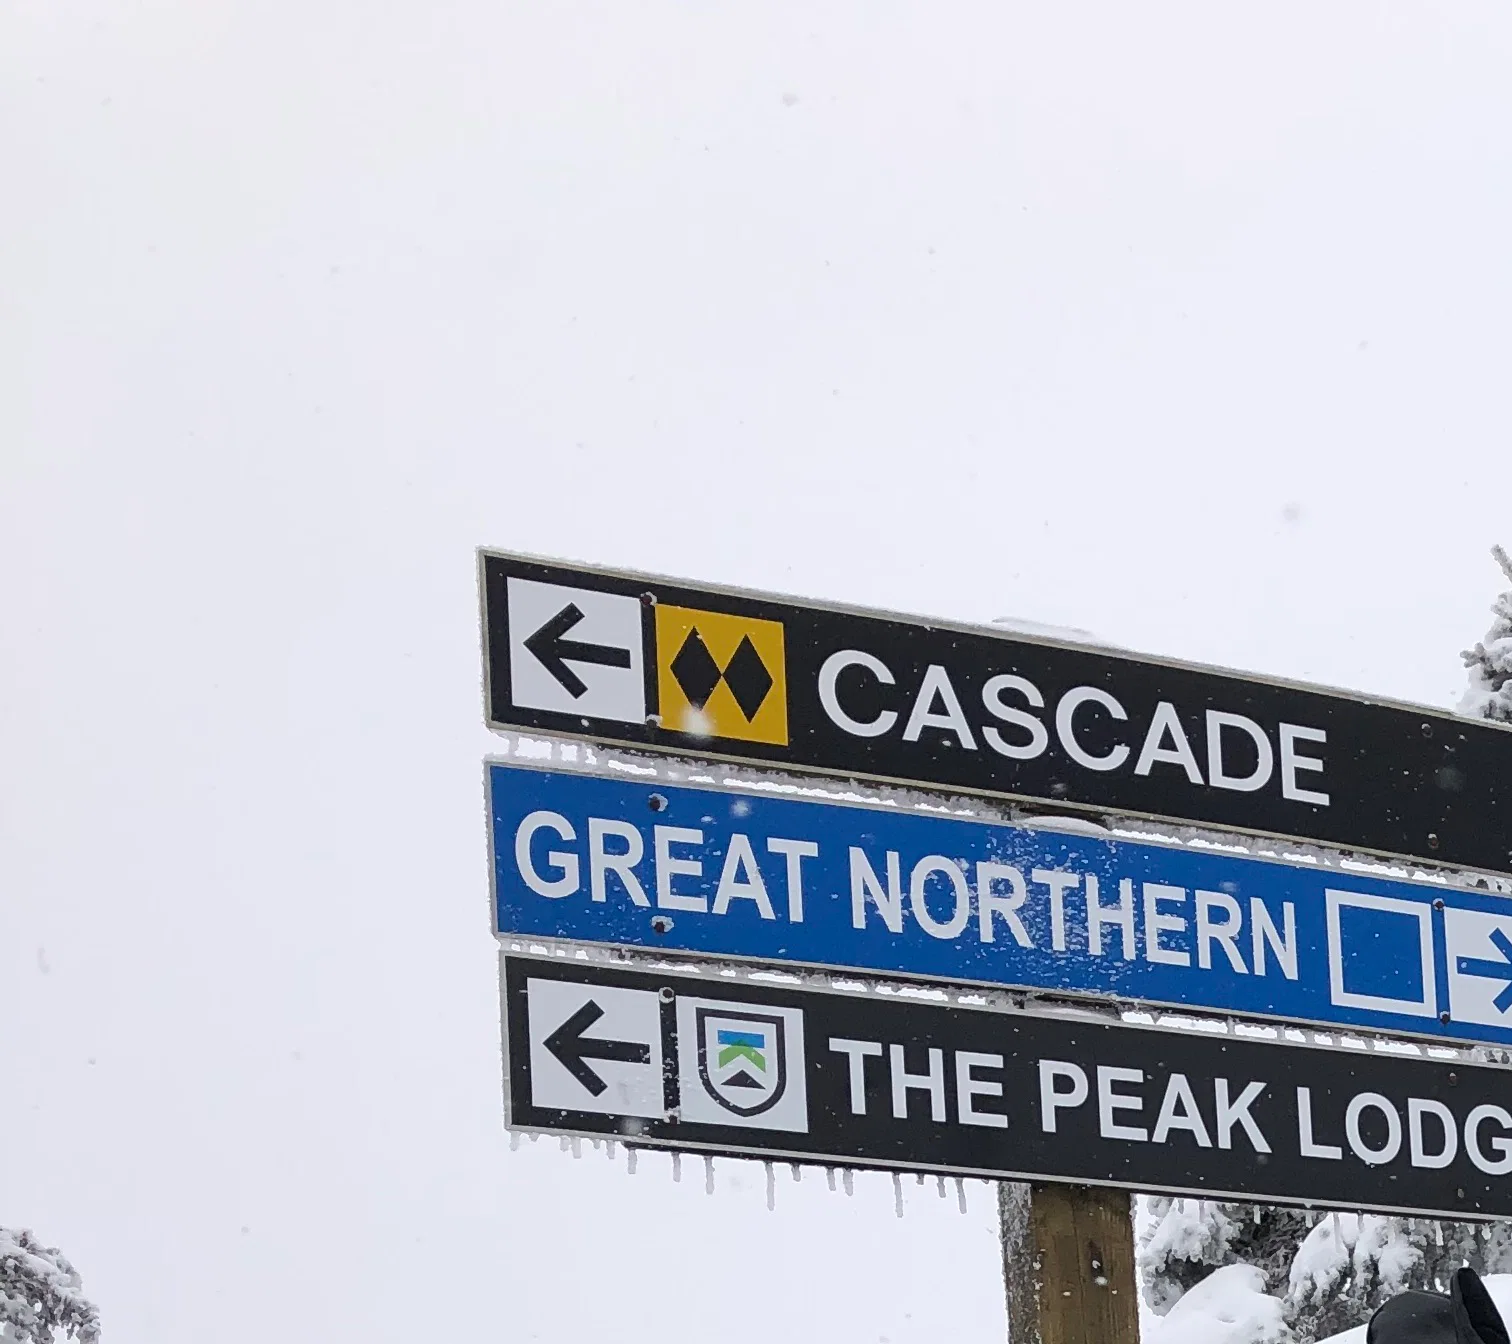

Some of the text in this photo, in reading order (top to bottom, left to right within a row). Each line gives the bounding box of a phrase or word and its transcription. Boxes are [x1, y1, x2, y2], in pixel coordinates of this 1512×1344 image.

[818, 648, 1330, 807] CASCADE
[514, 809, 1300, 981] GREAT NORTHERN
[828, 1036, 1010, 1130] THE
[1036, 1058, 1273, 1155] PEAK
